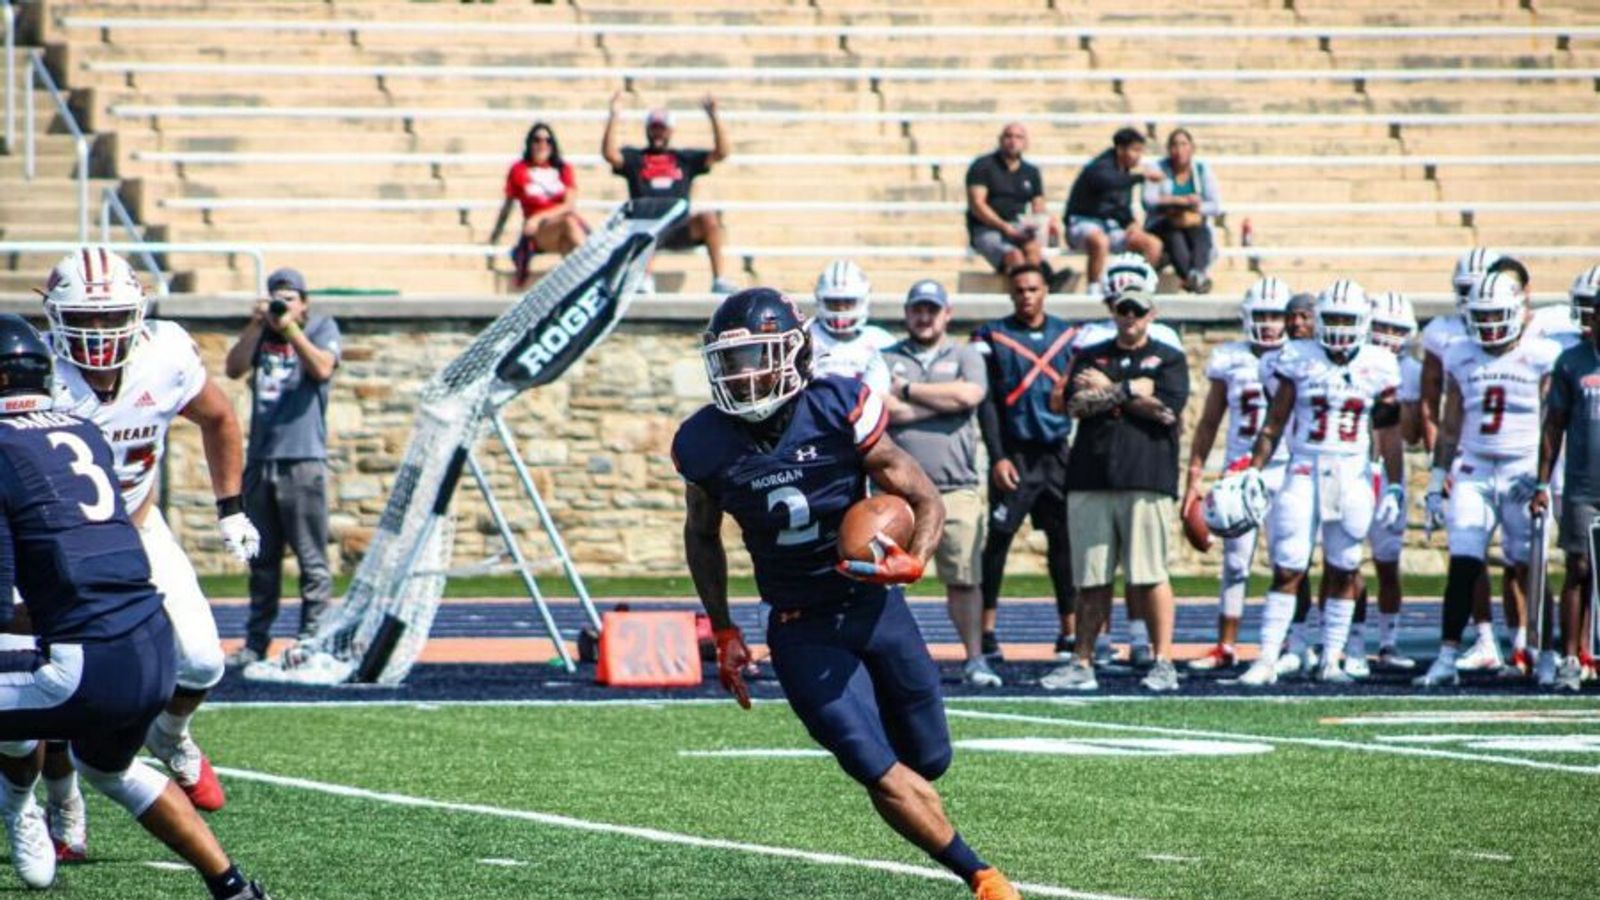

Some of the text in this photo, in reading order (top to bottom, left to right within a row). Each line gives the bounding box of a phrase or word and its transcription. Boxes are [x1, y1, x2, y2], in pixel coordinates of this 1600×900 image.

[5, 399, 37, 411] BEARS
[1479, 385, 1505, 435] 9
[112, 424, 158, 442] HEART
[46, 431, 115, 521] 3
[751, 469, 804, 490] MORGAN
[767, 485, 819, 546] 2
[617, 618, 690, 676] 20
